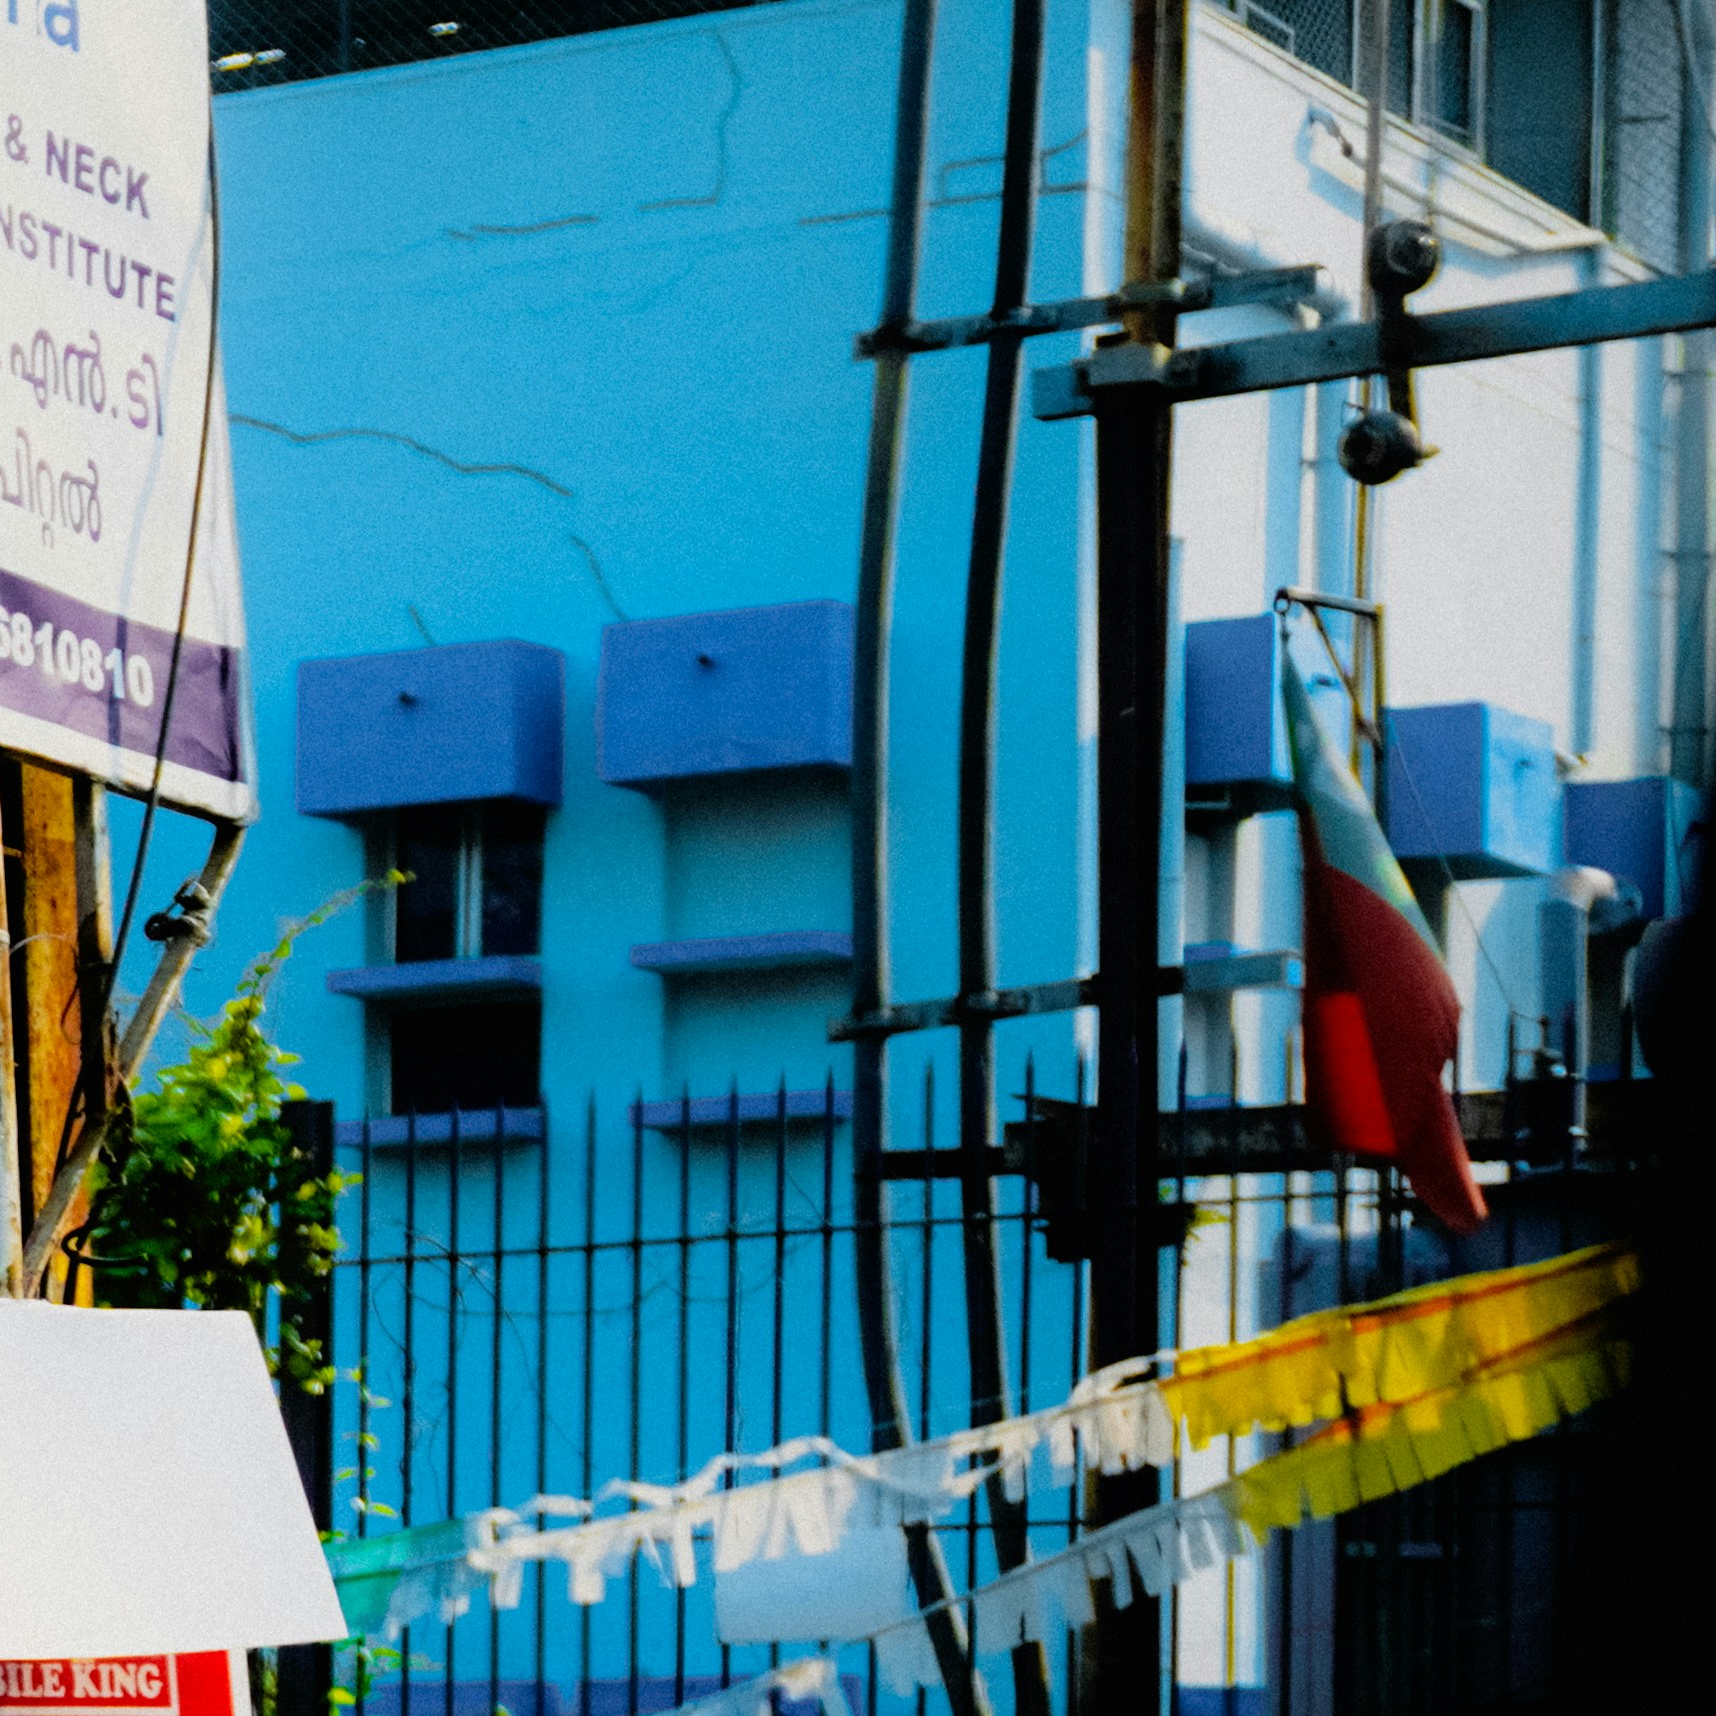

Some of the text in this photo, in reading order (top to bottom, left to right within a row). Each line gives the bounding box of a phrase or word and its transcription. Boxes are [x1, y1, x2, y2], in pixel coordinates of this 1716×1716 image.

[2, 114, 30, 161] &
[45, 128, 153, 219] NECK
[72, 1661, 165, 1698] KING
